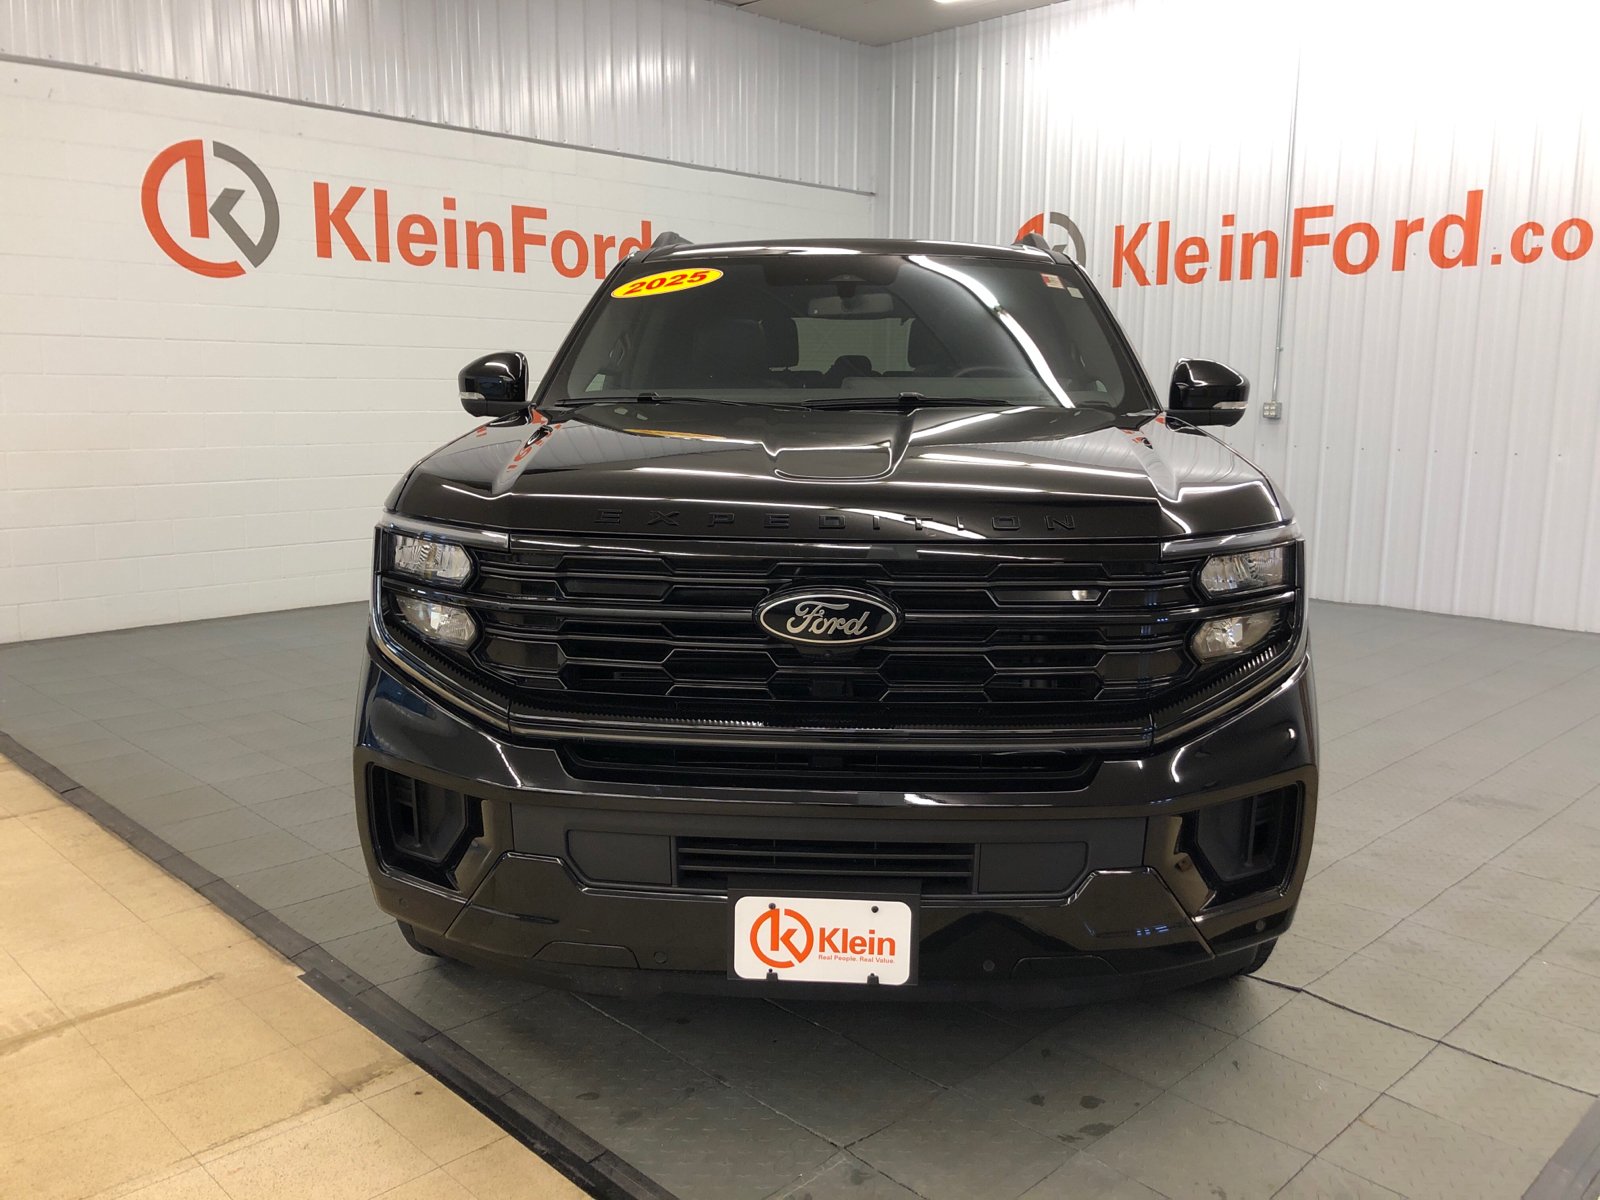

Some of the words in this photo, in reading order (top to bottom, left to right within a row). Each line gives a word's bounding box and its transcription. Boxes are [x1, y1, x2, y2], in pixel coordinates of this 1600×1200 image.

[1112, 189, 1594, 288] KleinFord.co
[621, 270, 711, 296] 2025
[595, 508, 1076, 531] EXPEDITION
[786, 600, 869, 636] Ford
[818, 927, 896, 956] Klein
[834, 954, 857, 962] People.
[875, 956, 896, 964] Value.
